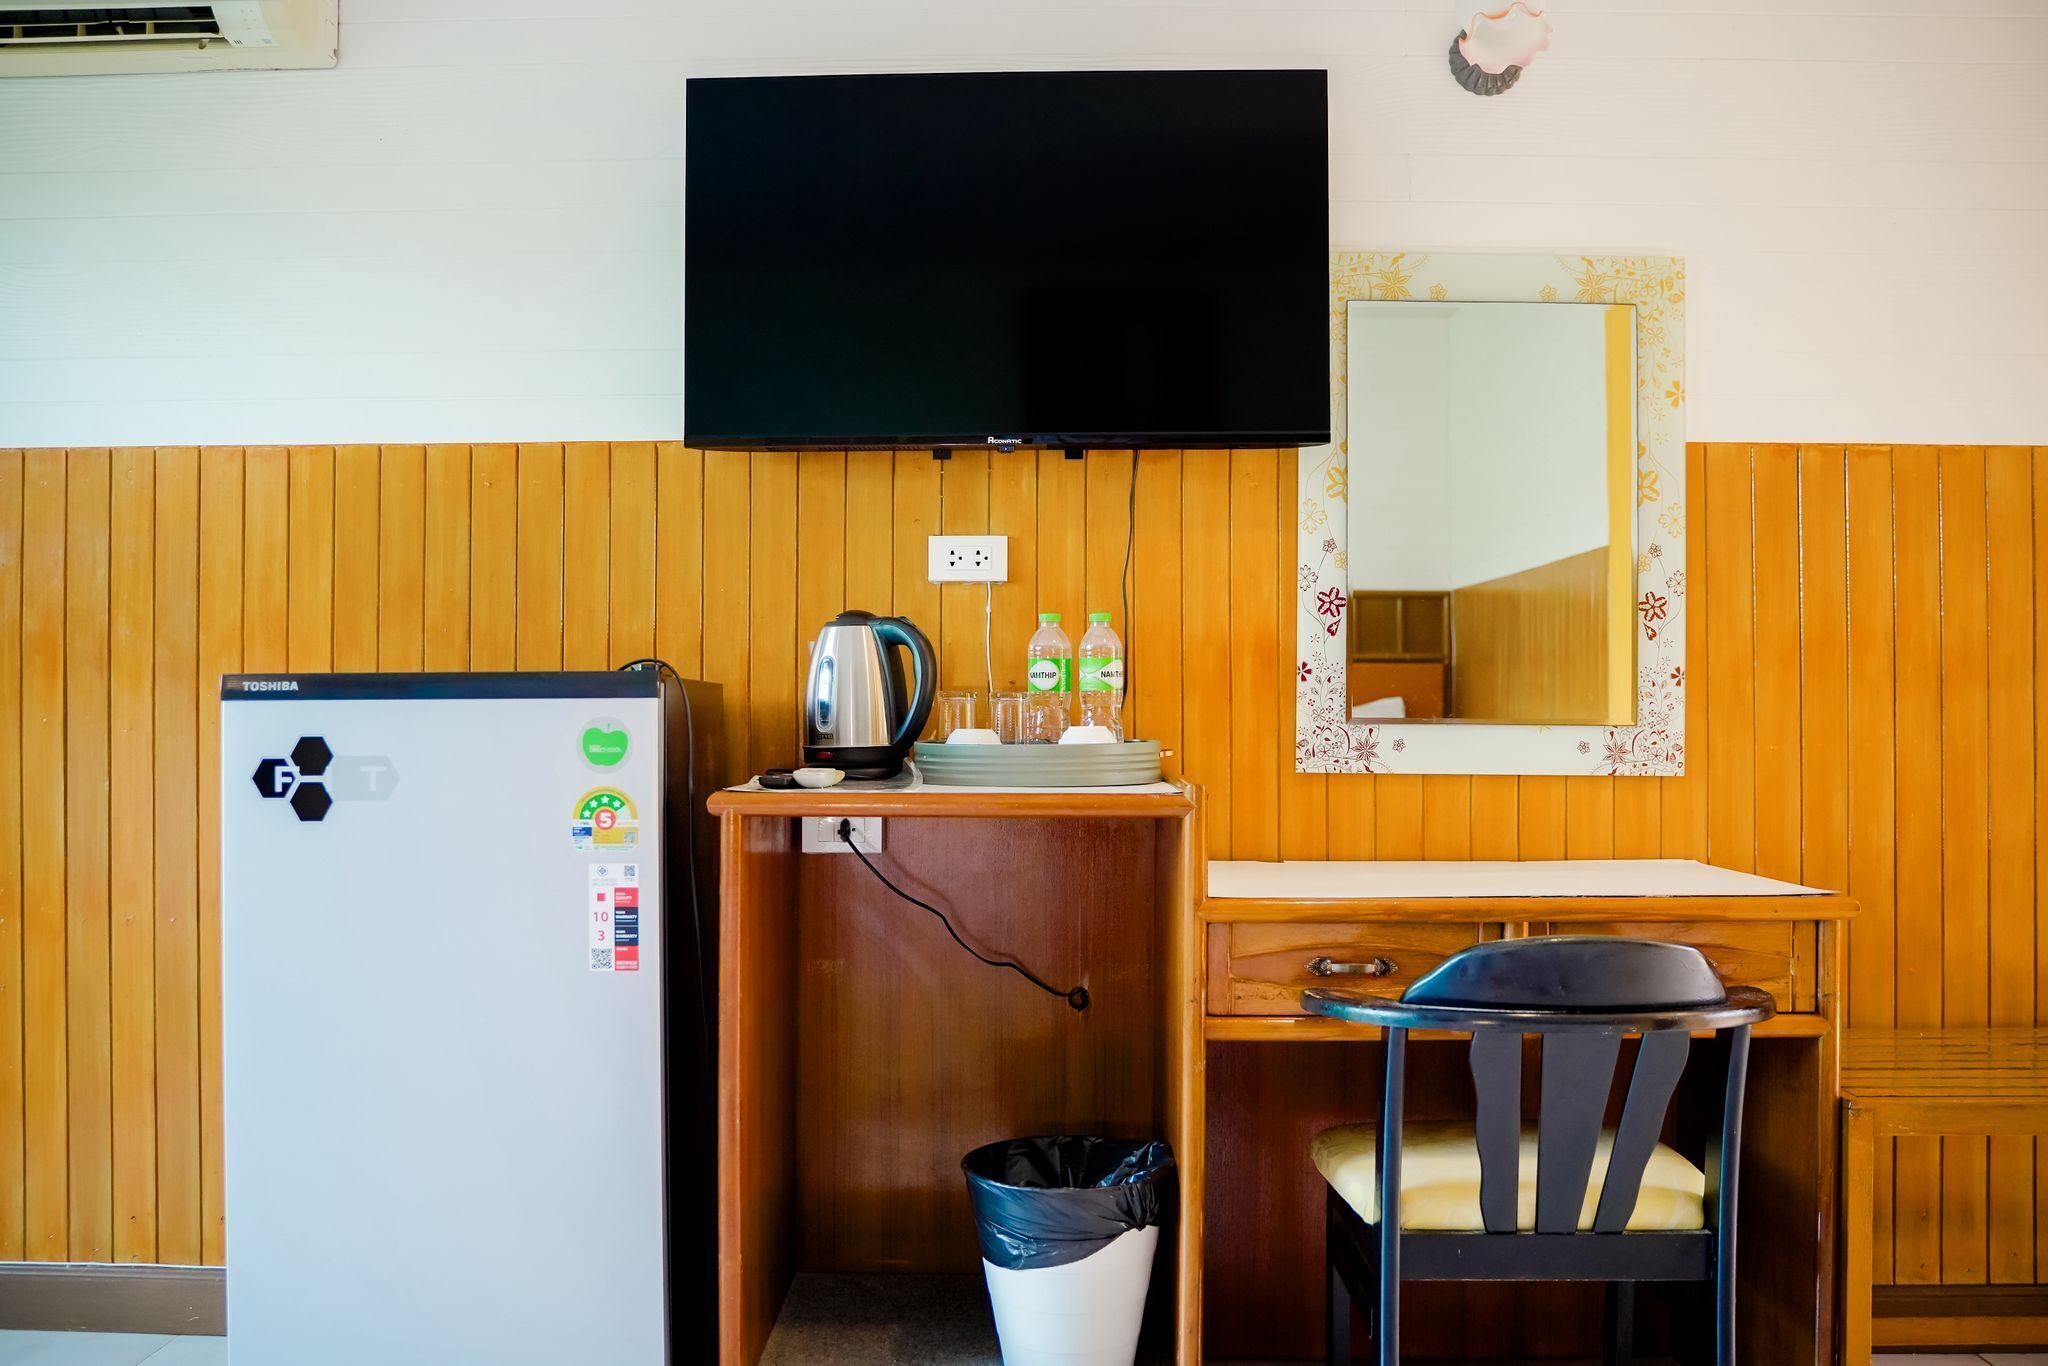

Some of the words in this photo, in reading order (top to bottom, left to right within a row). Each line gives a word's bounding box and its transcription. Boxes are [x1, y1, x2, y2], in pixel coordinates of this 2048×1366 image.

[242, 681, 299, 691] TOSHIBA
[599, 811, 612, 828] 5
[593, 911, 609, 922] 10
[597, 930, 606, 941] 3
